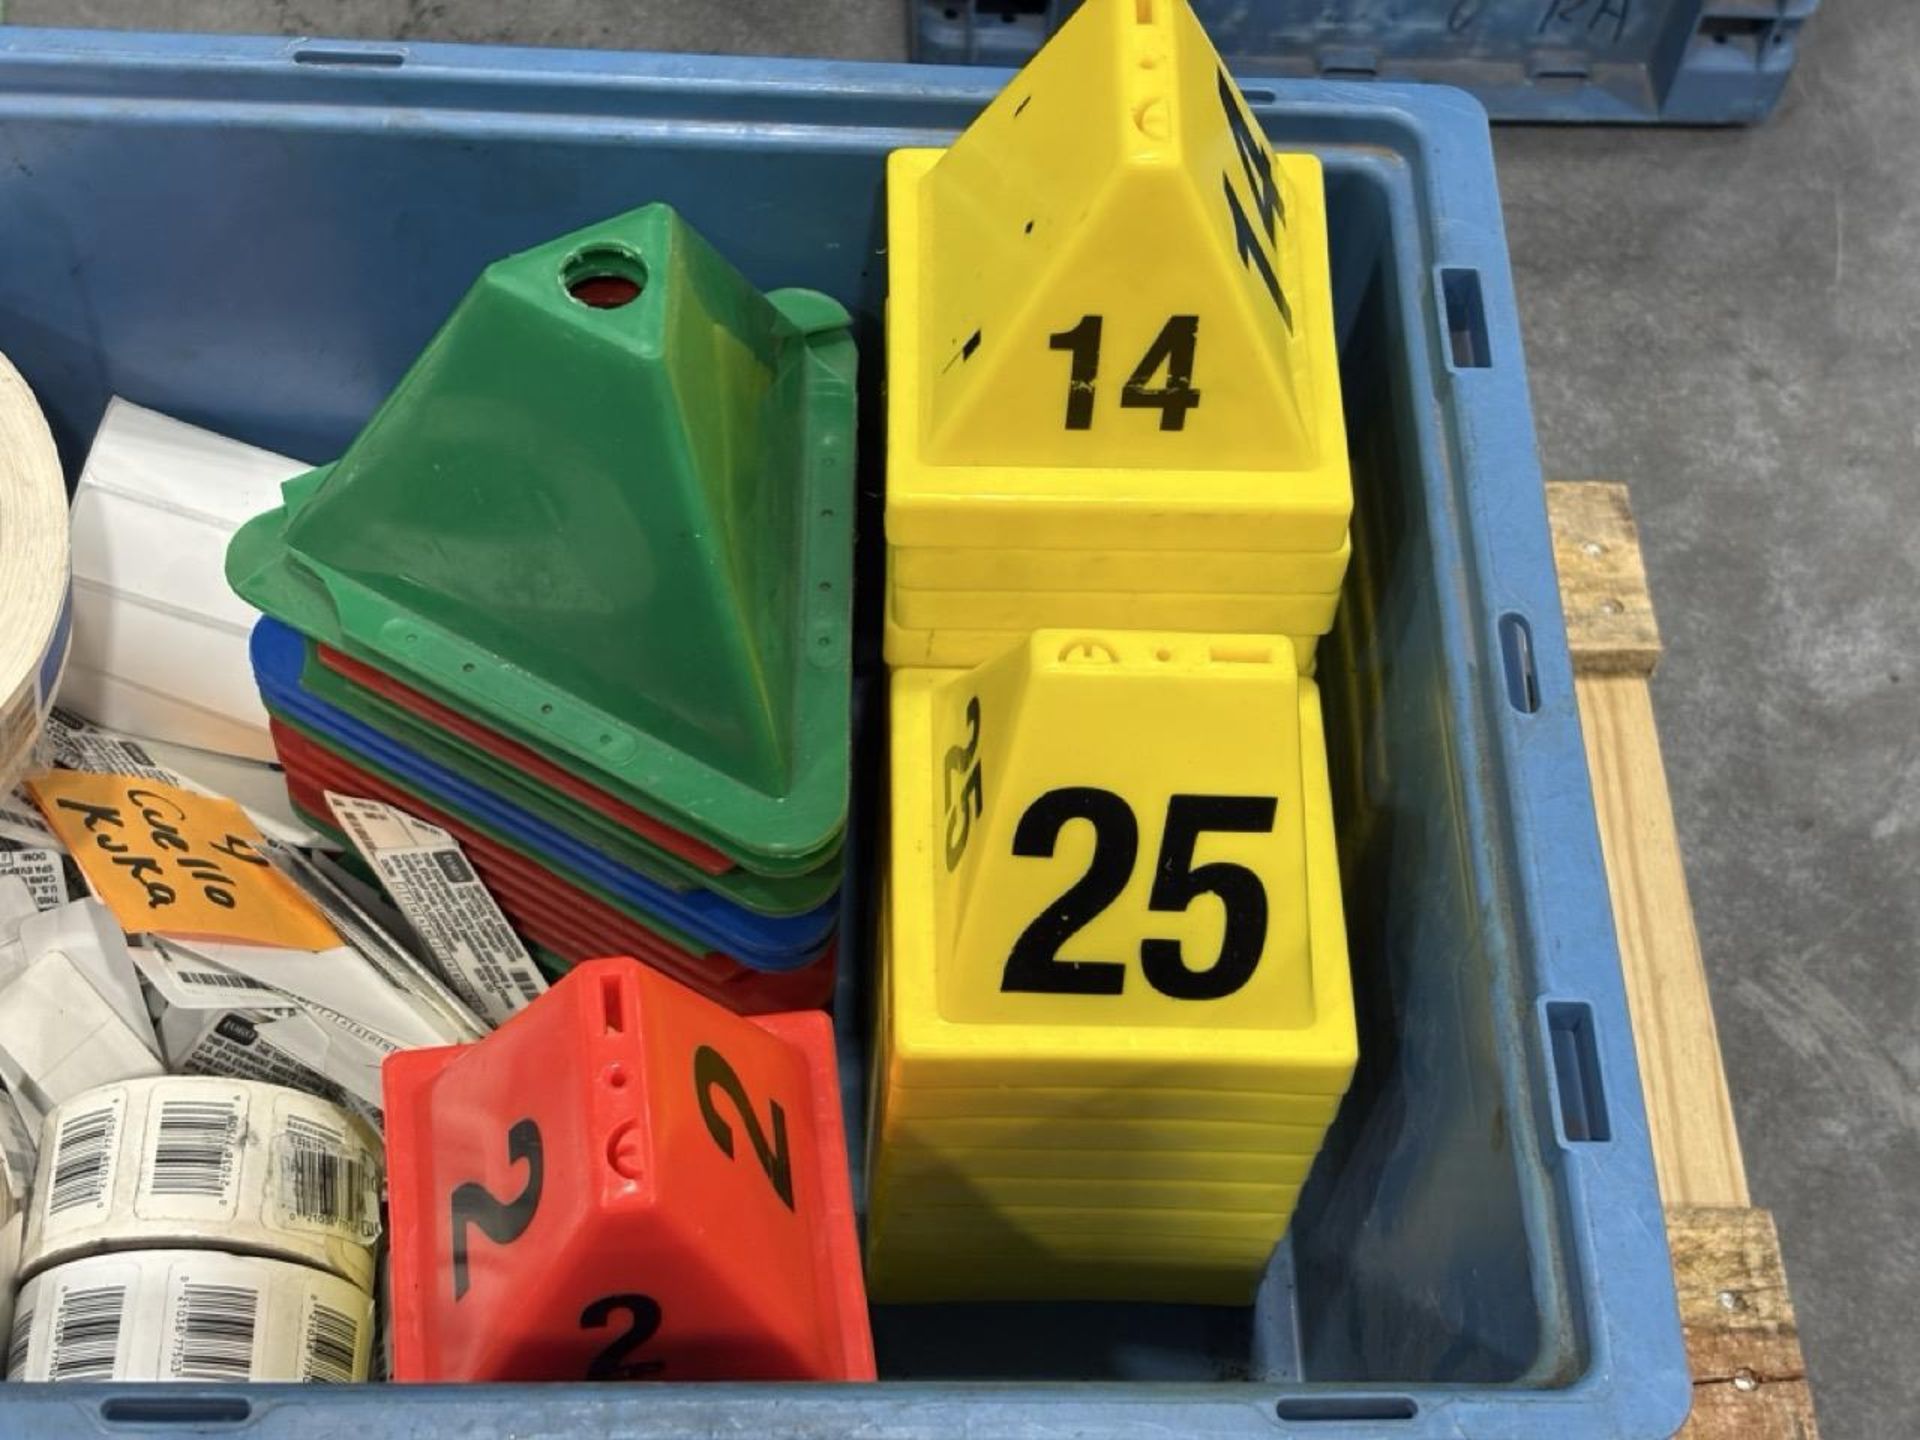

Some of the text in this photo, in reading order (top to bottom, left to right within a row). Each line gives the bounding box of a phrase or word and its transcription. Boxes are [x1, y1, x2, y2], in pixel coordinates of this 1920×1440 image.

[1217, 64, 1294, 337] 14
[1048, 314, 1200, 431] 14
[943, 695, 984, 873] 25
[1000, 786, 1279, 1000] 25
[451, 1117, 544, 1303] 2
[693, 1045, 795, 1213] 2
[579, 1293, 669, 1382] 2
